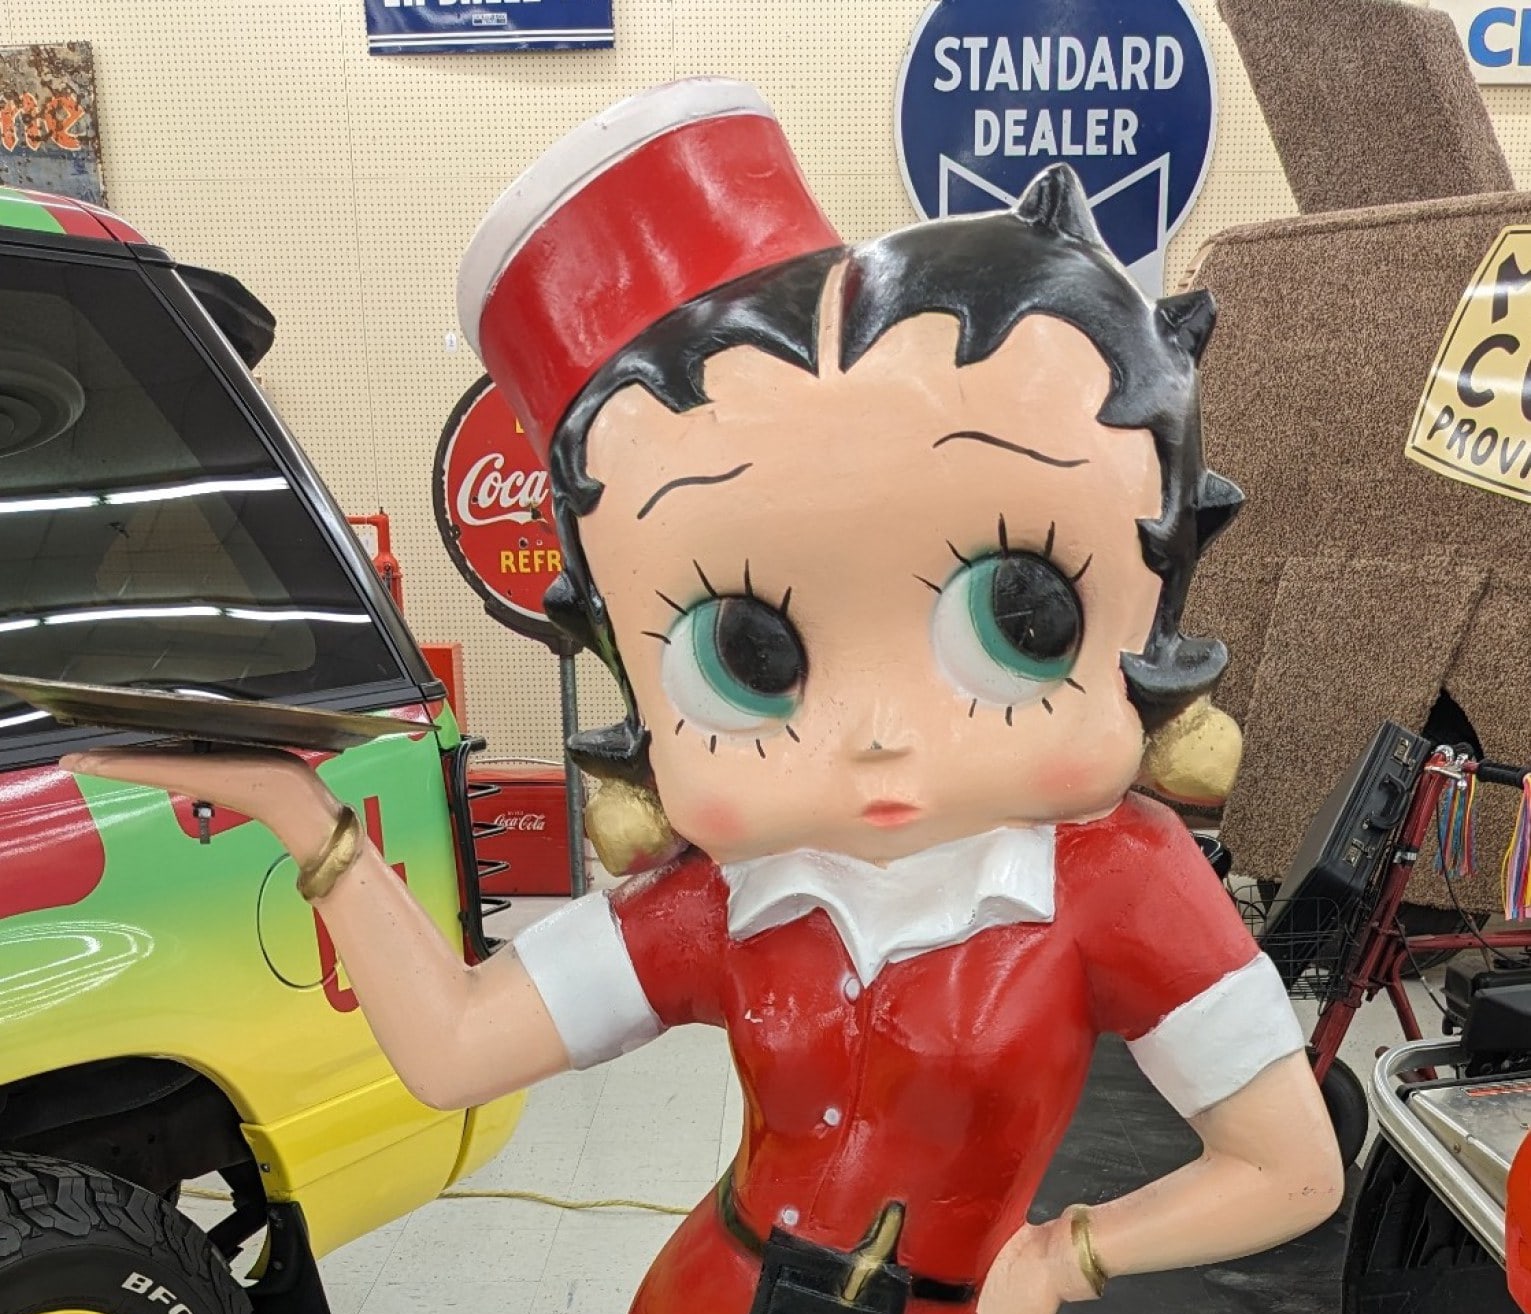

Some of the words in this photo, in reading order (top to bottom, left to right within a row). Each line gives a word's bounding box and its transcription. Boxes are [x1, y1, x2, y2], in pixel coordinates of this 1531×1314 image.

[934, 36, 1184, 92] STANDARD
[1468, 7, 1531, 67] C
[974, 109, 1139, 157] DEALER
[1457, 333, 1531, 422] C
